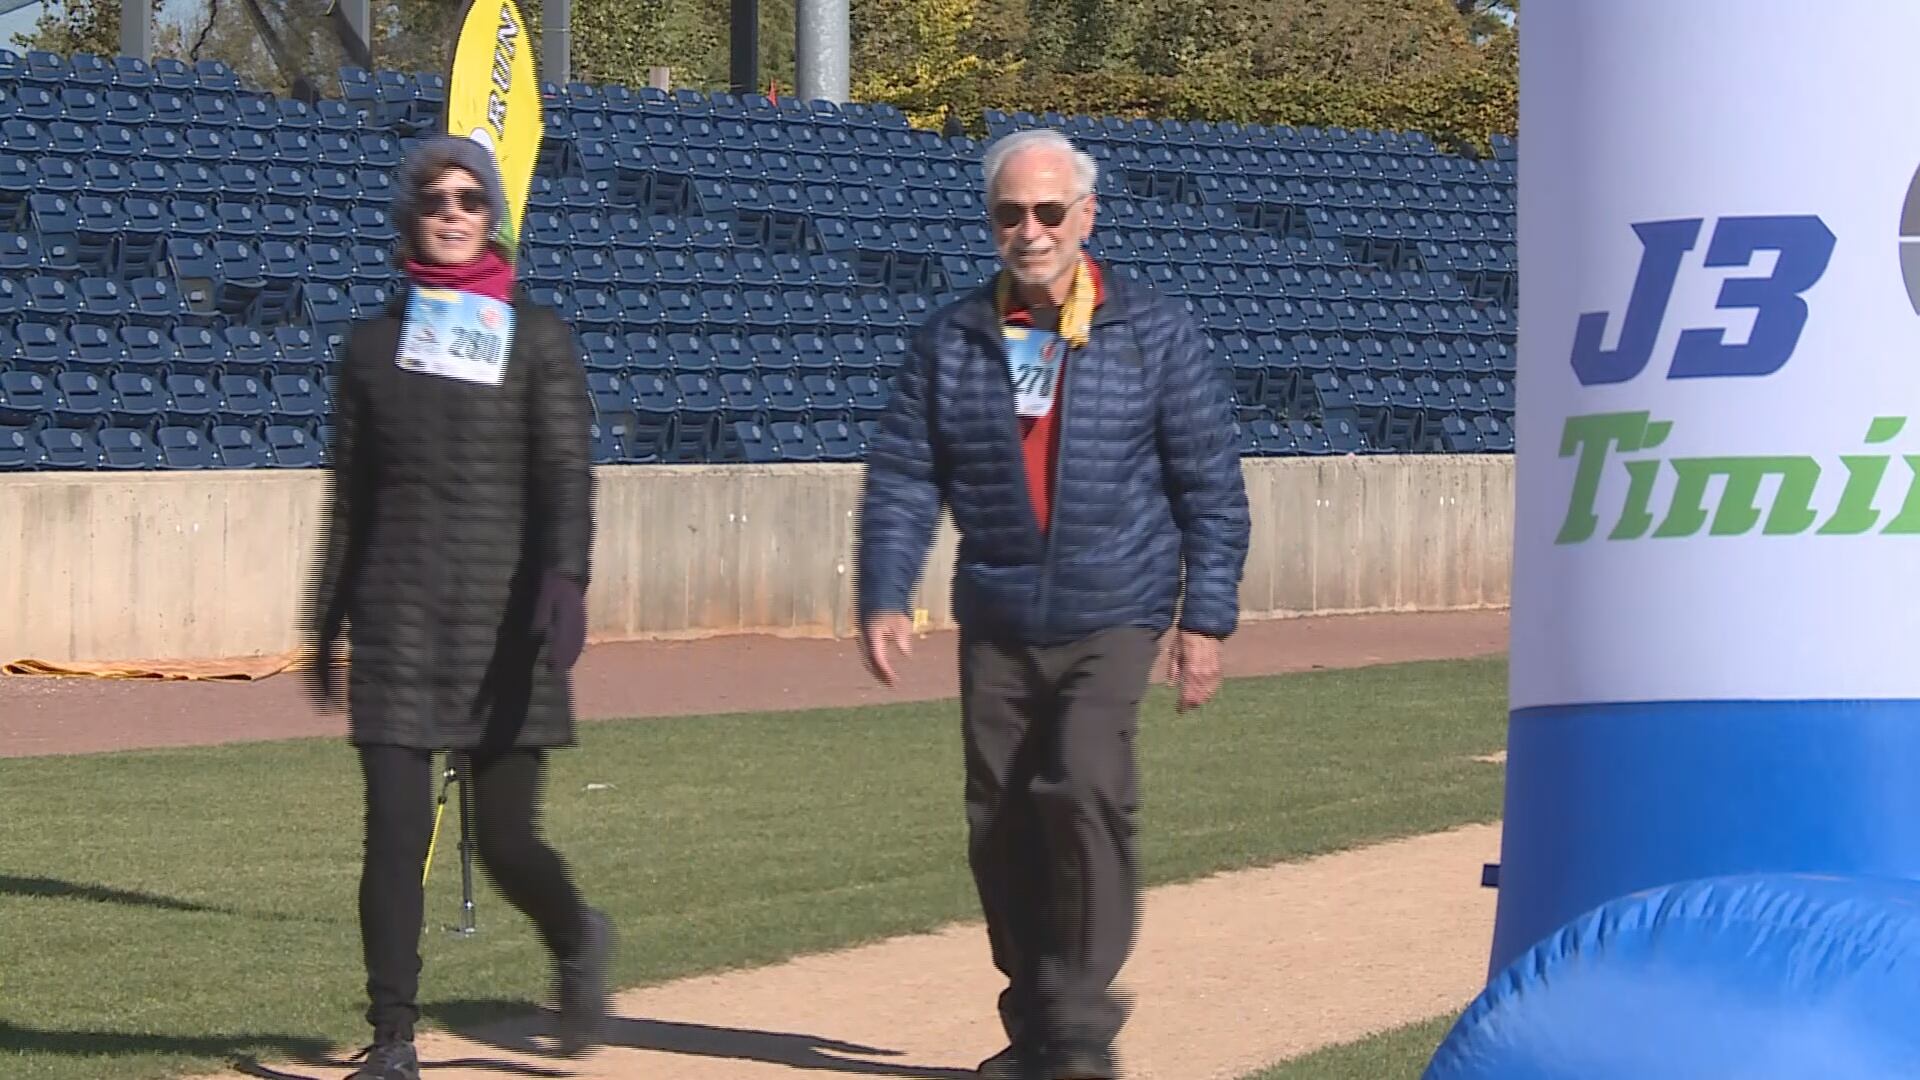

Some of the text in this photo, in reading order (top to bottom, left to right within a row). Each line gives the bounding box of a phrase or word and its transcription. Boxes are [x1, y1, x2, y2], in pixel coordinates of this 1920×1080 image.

[487, 3, 520, 141] RUN
[447, 326, 502, 366] 280
[1570, 214, 1838, 387] J3
